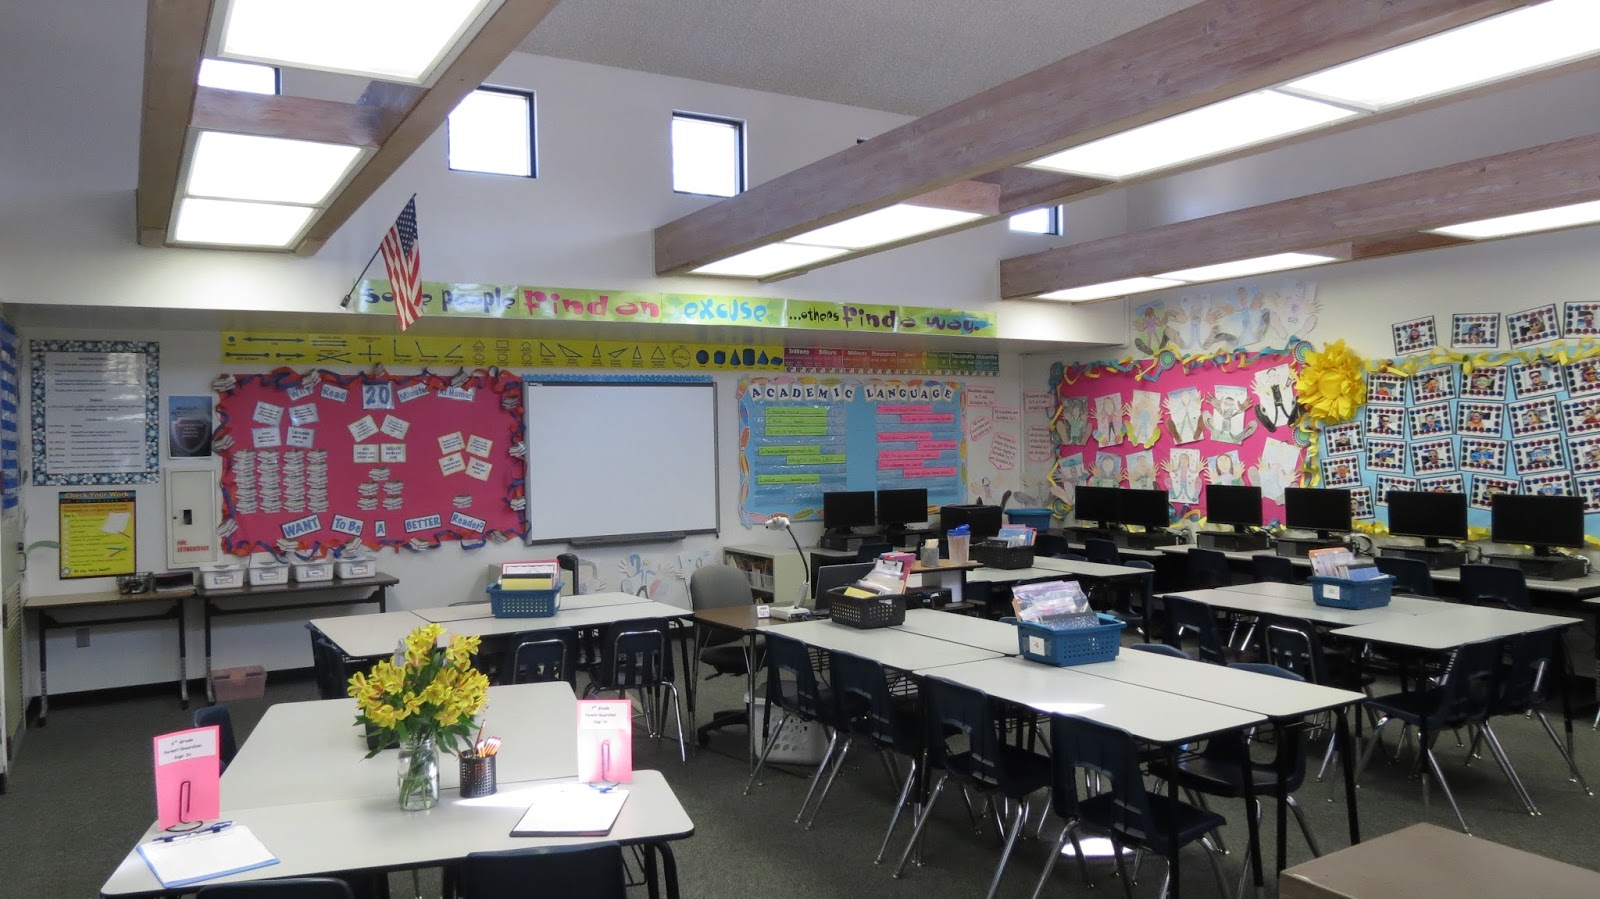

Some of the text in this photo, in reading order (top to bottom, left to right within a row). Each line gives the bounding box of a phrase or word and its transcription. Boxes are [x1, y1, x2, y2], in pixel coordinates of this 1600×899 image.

[364, 288, 433, 306] Soe
[615, 301, 660, 318] an
[683, 298, 767, 322] excuse
[322, 386, 346, 400] Read
[364, 386, 390, 406] 20
[752, 387, 952, 399] ACADEMIC LANGUAGE
[284, 514, 484, 537] WANT To Be A BETTER Reader?
